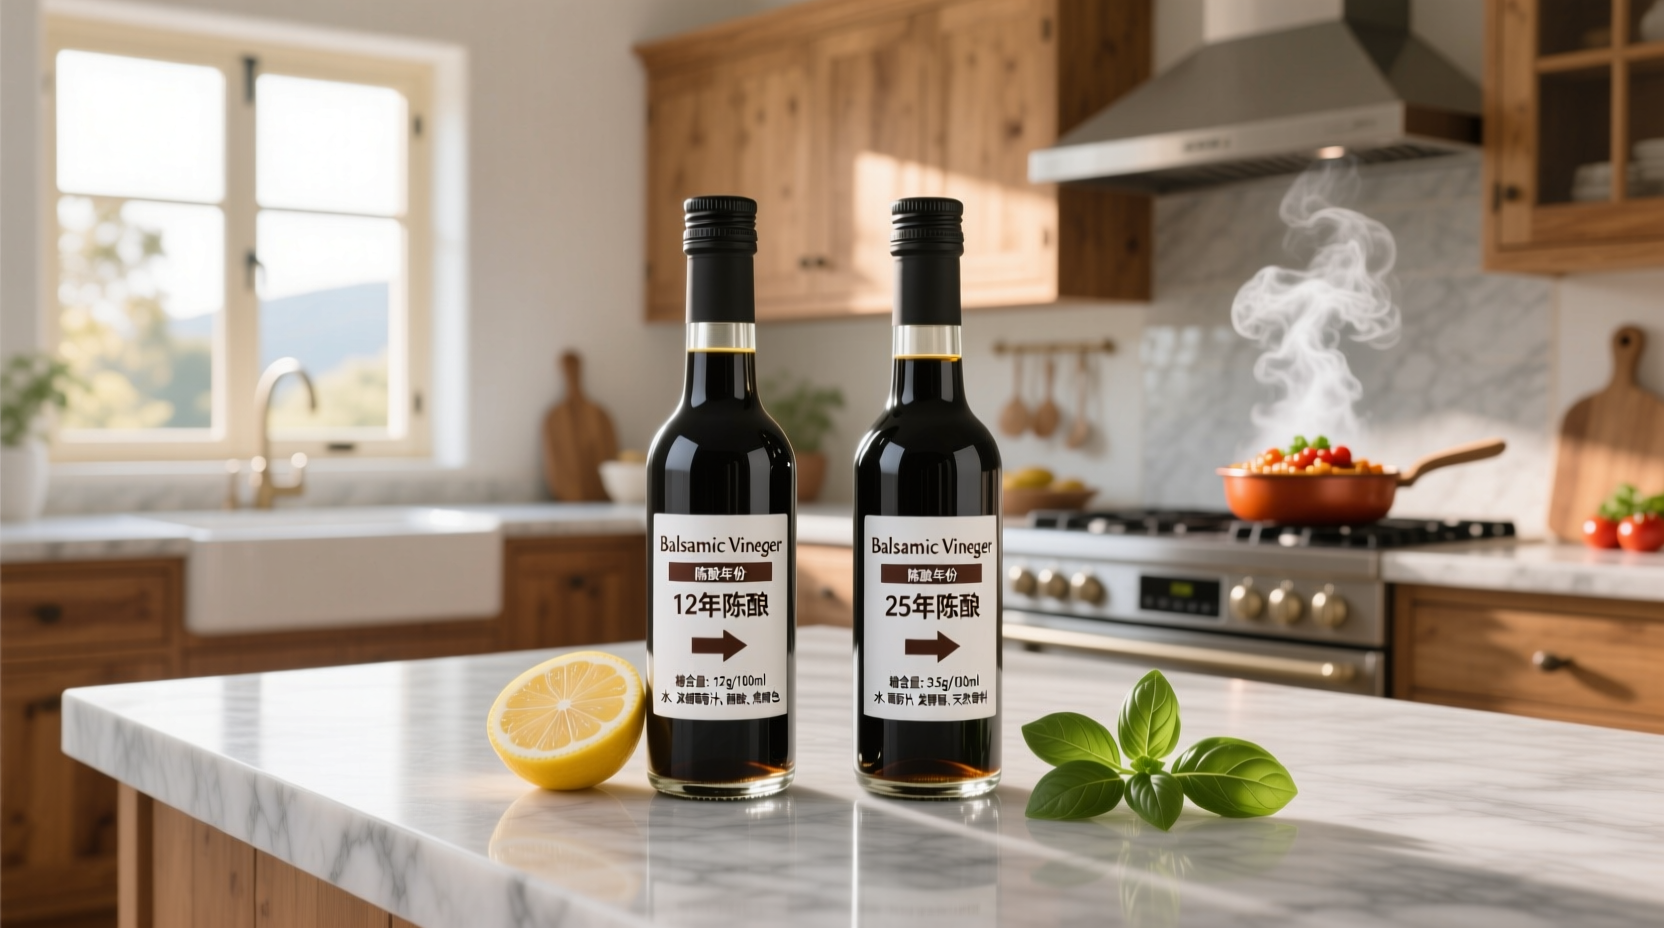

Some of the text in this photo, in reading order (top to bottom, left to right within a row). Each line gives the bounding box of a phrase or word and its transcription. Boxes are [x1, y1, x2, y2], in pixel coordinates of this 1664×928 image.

[660, 535, 782, 557] Balsamic Vineger
[872, 537, 992, 558] Balsamic Vineger
[673, 591, 769, 618] 12年陈酿
[885, 592, 980, 620] 25年陈酿
